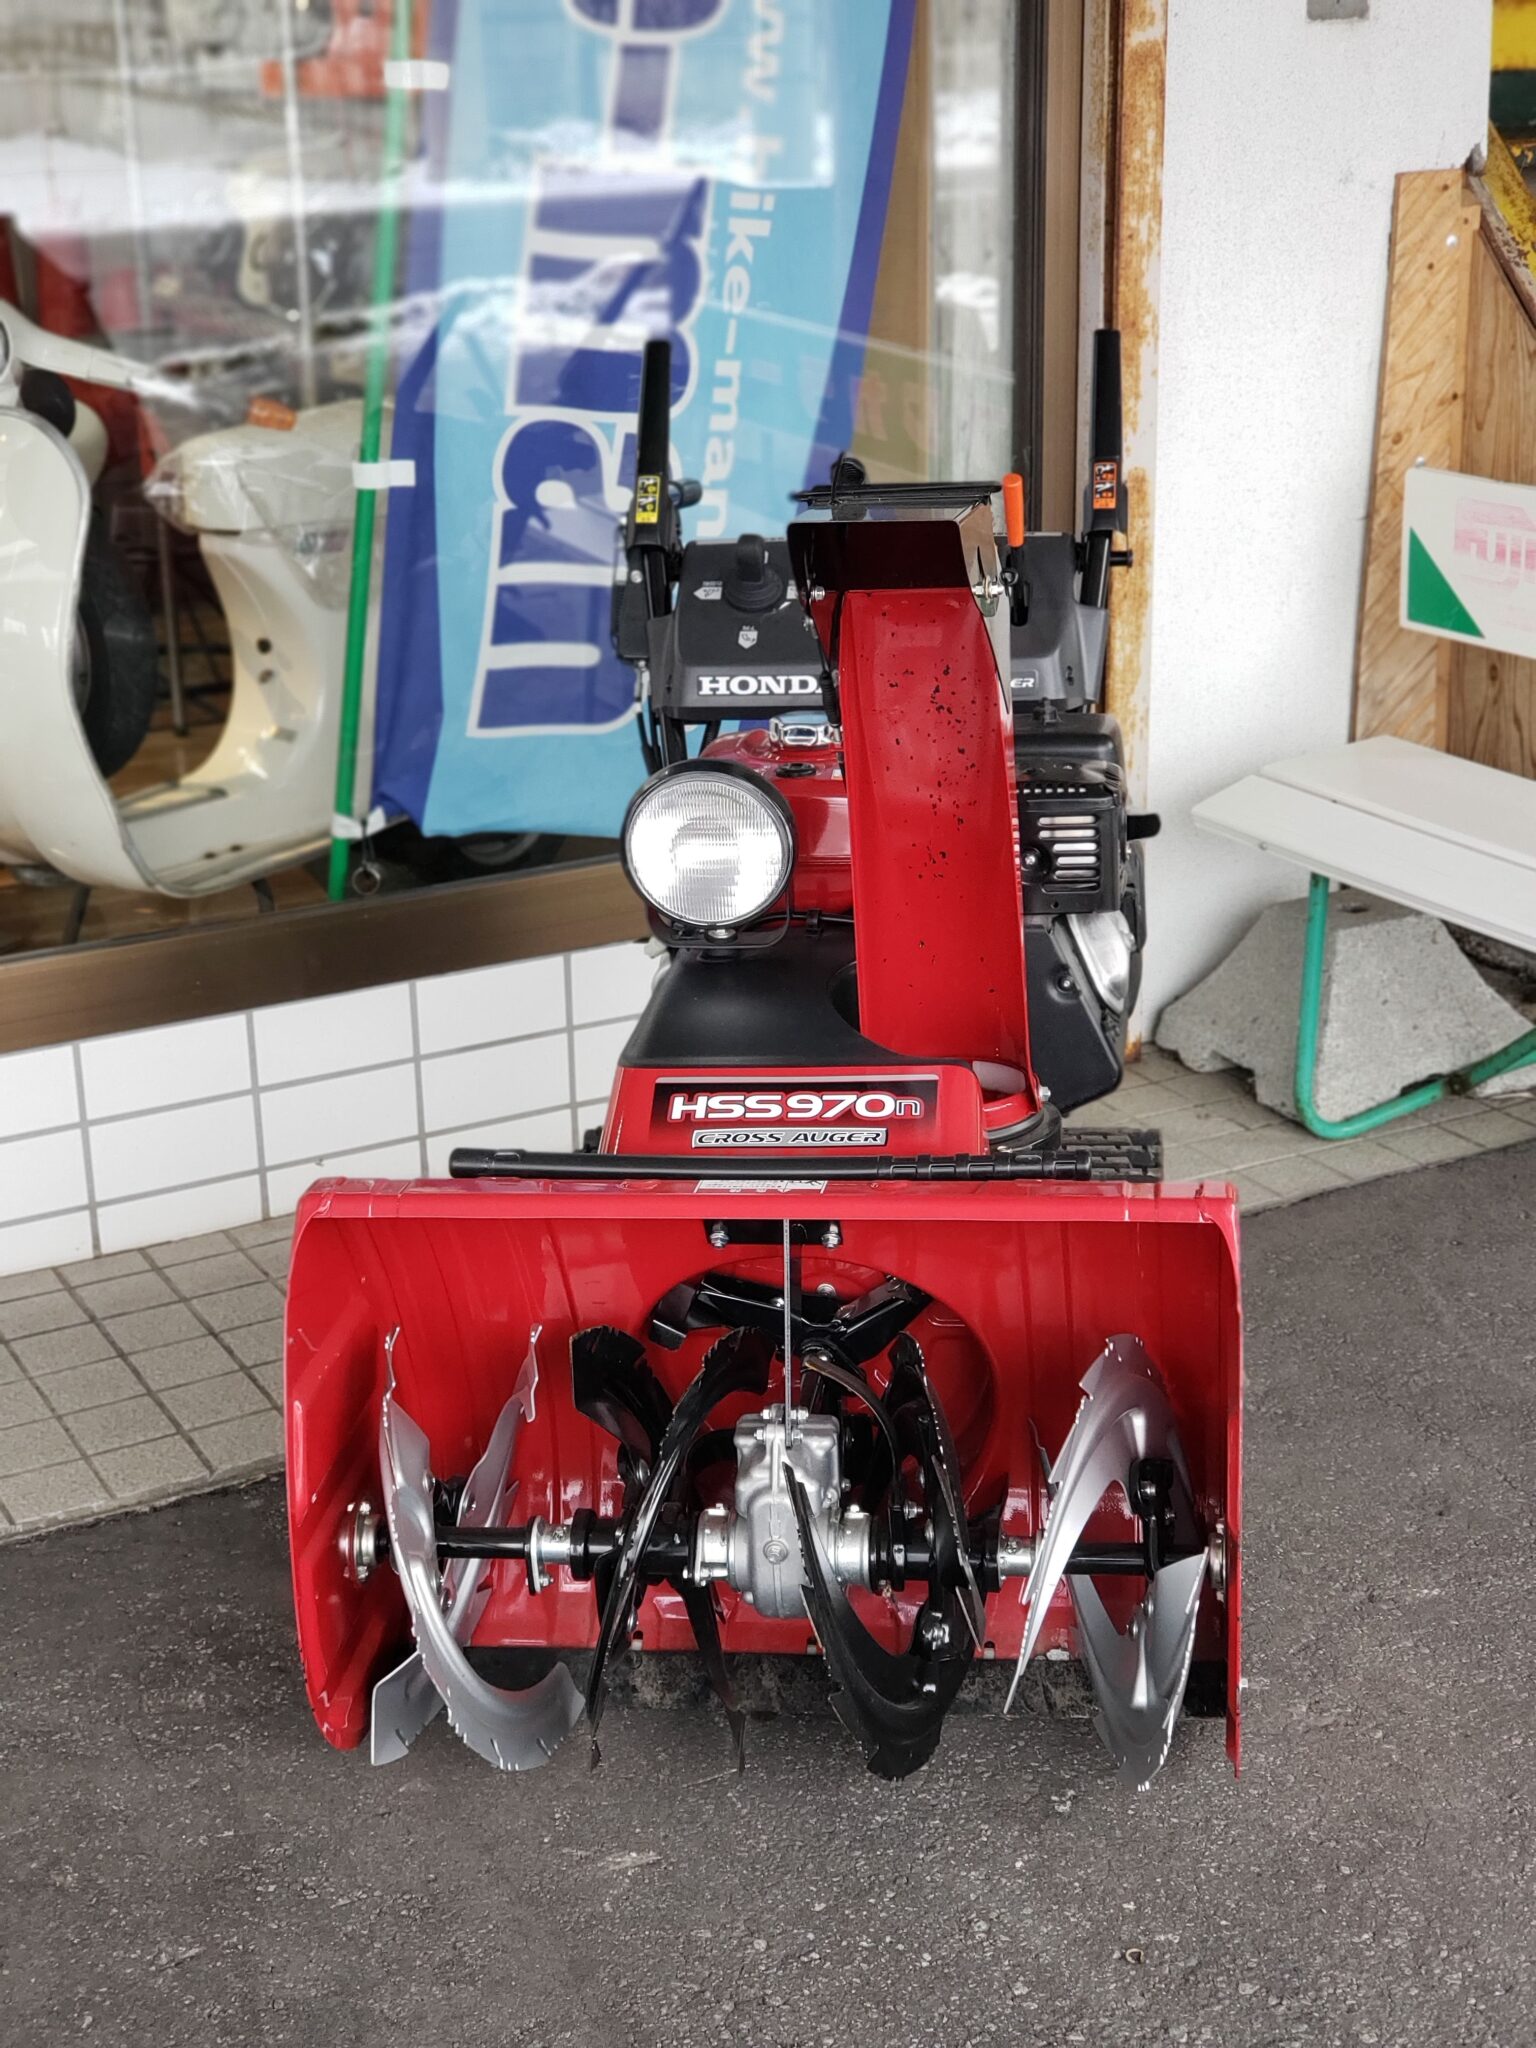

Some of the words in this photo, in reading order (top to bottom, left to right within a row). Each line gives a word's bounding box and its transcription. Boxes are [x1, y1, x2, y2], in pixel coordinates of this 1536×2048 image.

[698, 675, 822, 695] HOND
[1009, 677, 1035, 689] ER
[669, 1093, 922, 1121] HSS970n
[697, 1131, 782, 1145] CROSS
[790, 1131, 881, 1144] AUGER
